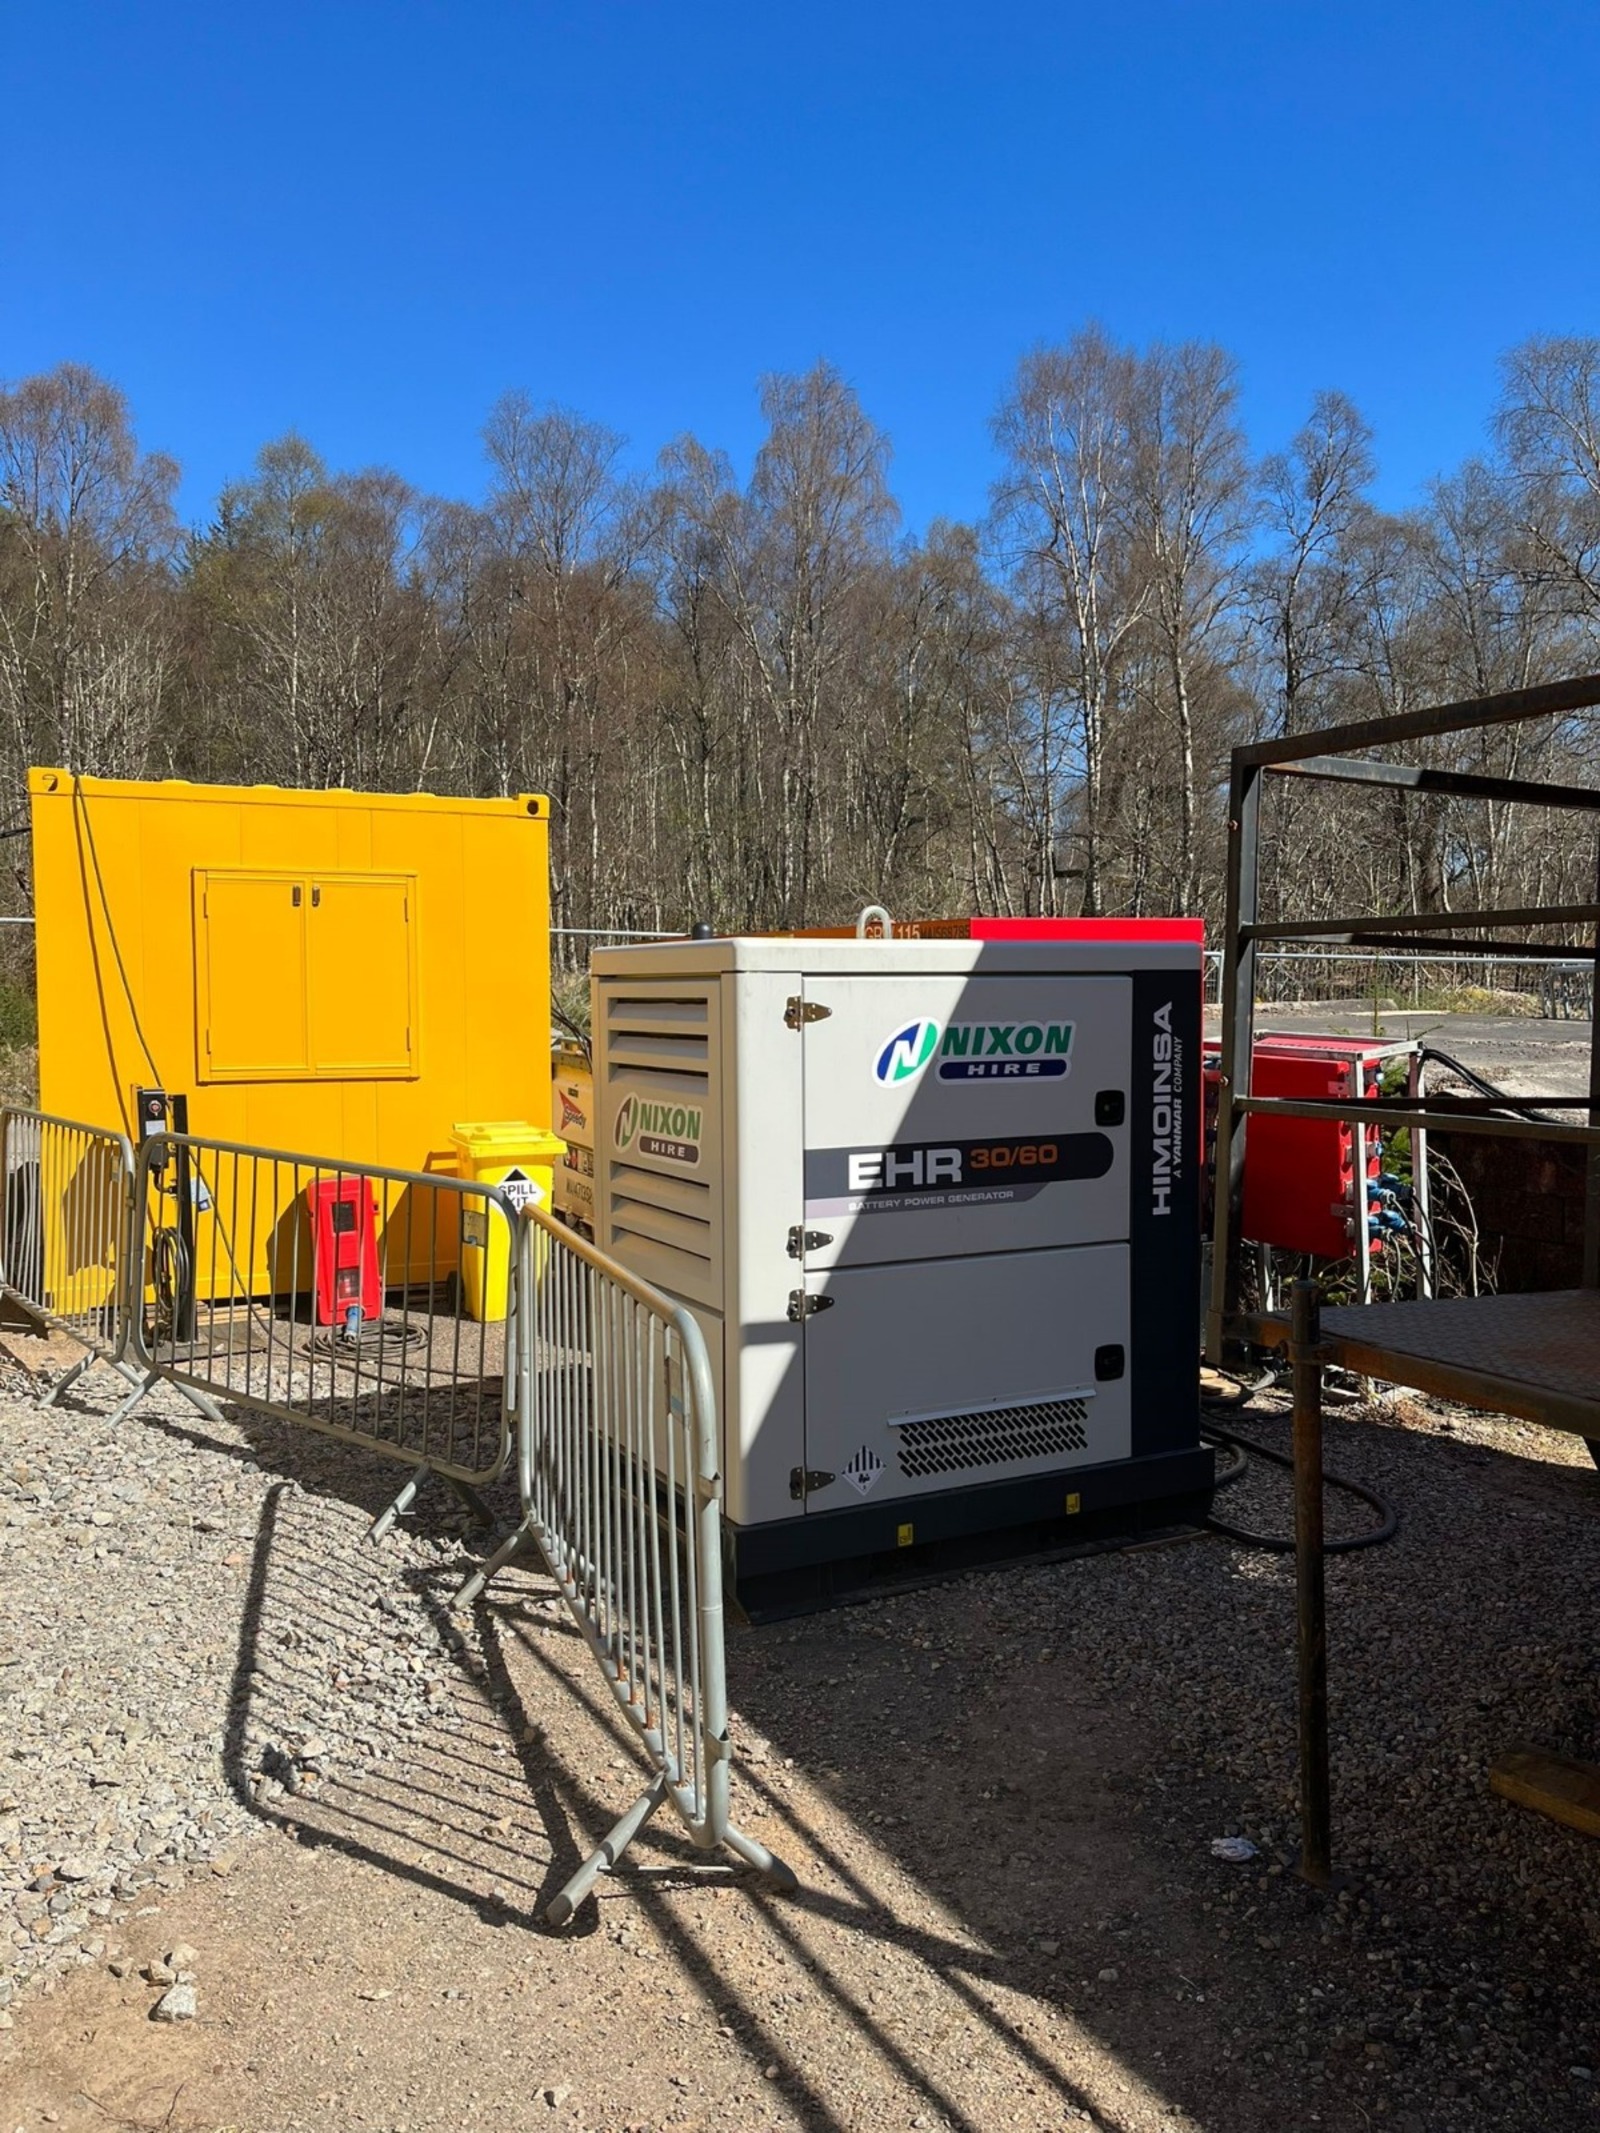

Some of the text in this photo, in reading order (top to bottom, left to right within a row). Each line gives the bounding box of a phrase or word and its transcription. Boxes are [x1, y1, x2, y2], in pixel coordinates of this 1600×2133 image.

[941, 1025, 1073, 1056] NIXON
[967, 1063, 1041, 1076] HIRE
[640, 1103, 701, 1140] NIXON
[1152, 1001, 1172, 1215] HIMOINSA
[1173, 1036, 1183, 1178] A YANMAR COMPANY
[651, 1141, 685, 1157] HIRE
[848, 1144, 1058, 1190] EHR 30/60
[848, 1190, 1014, 1211] BATTERY POWER GENERATOR
